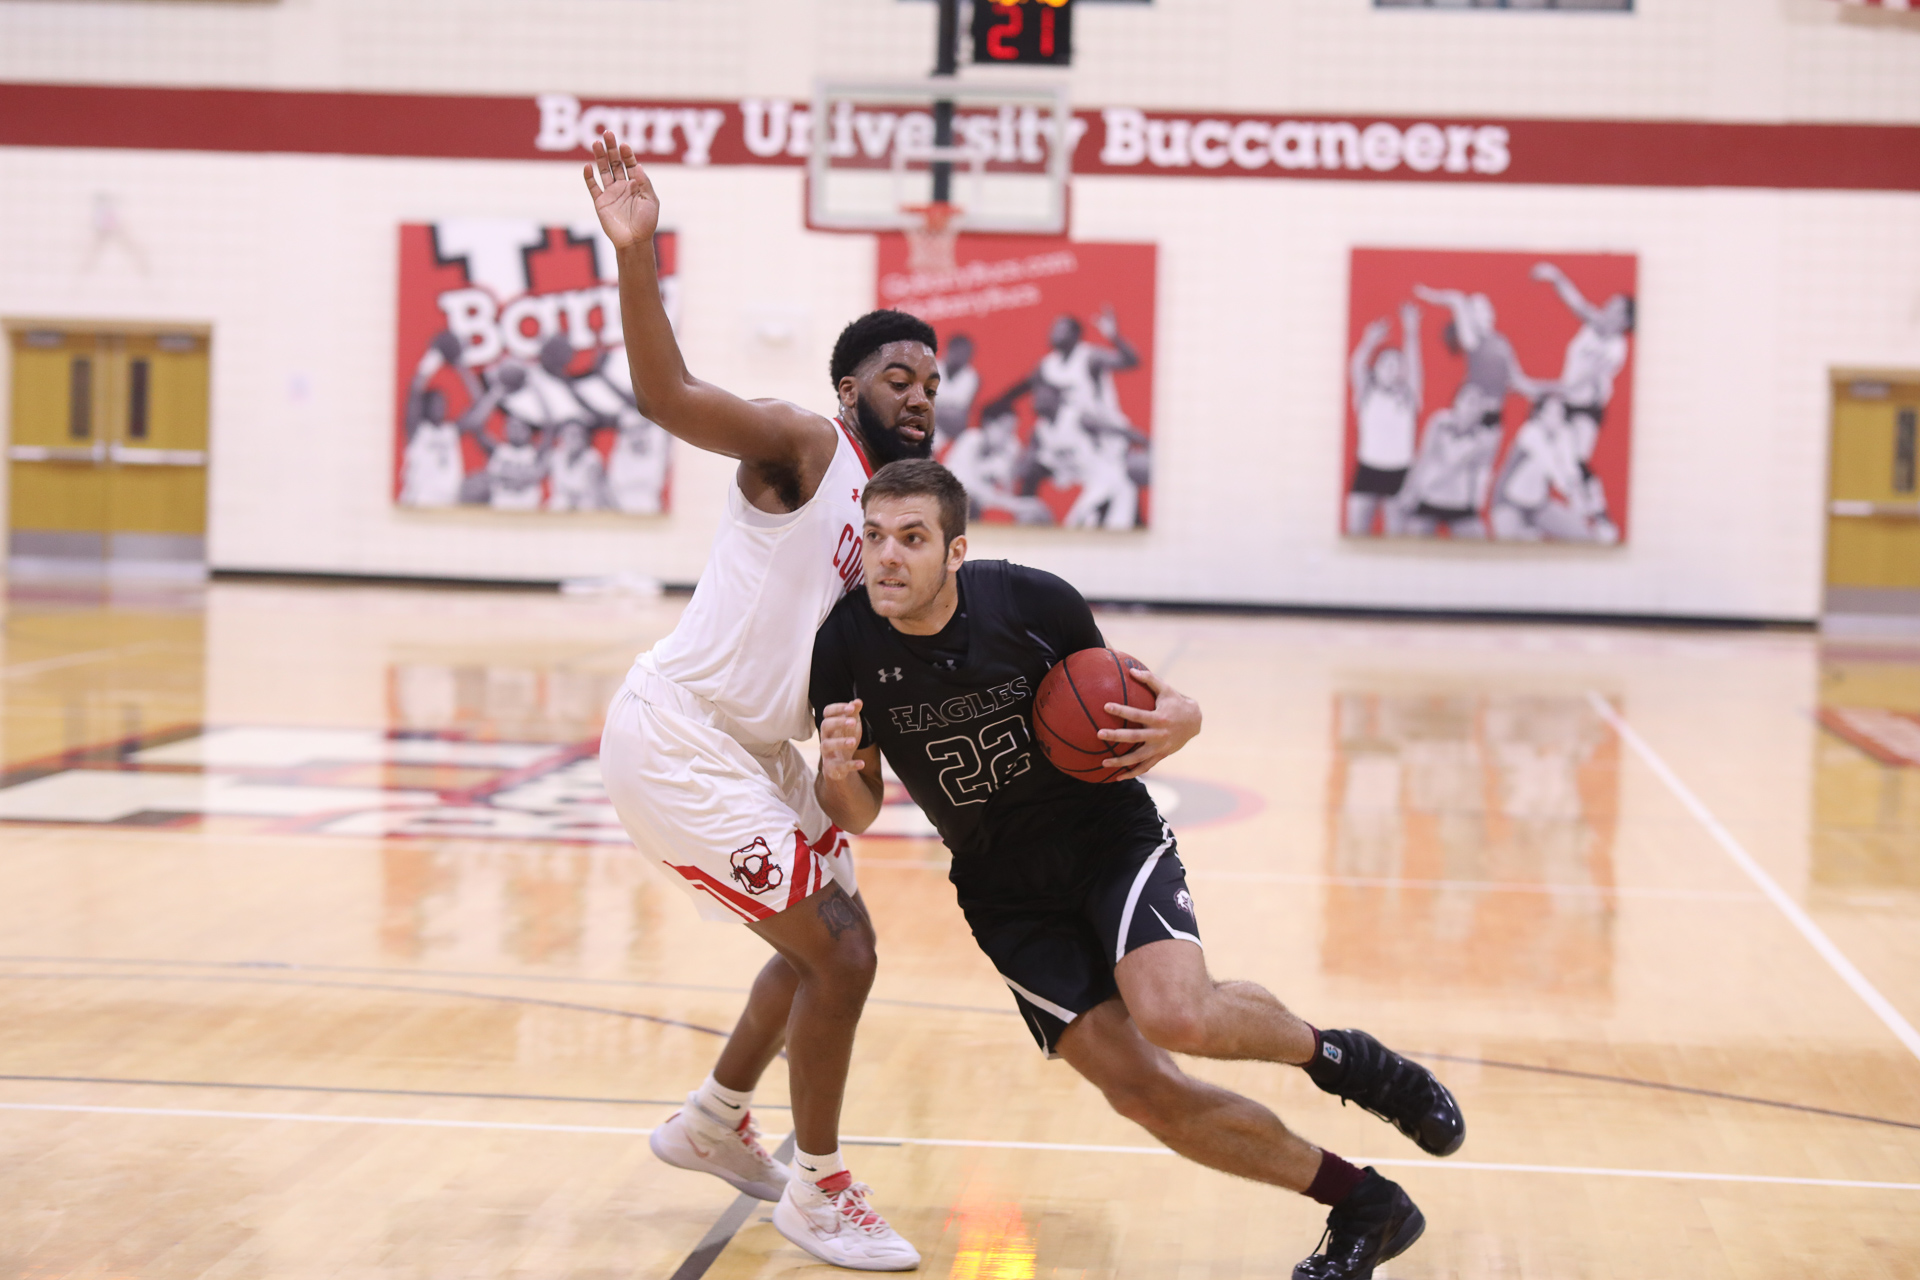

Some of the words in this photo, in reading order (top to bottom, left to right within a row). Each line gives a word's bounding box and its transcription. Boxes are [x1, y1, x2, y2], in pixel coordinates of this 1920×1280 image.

[986, 2, 1056, 60] 21
[535, 93, 725, 167] Barry
[1100, 106, 1511, 174] Buccaneers
[889, 676, 1033, 733] EAGLES
[926, 714, 1031, 806] 22
